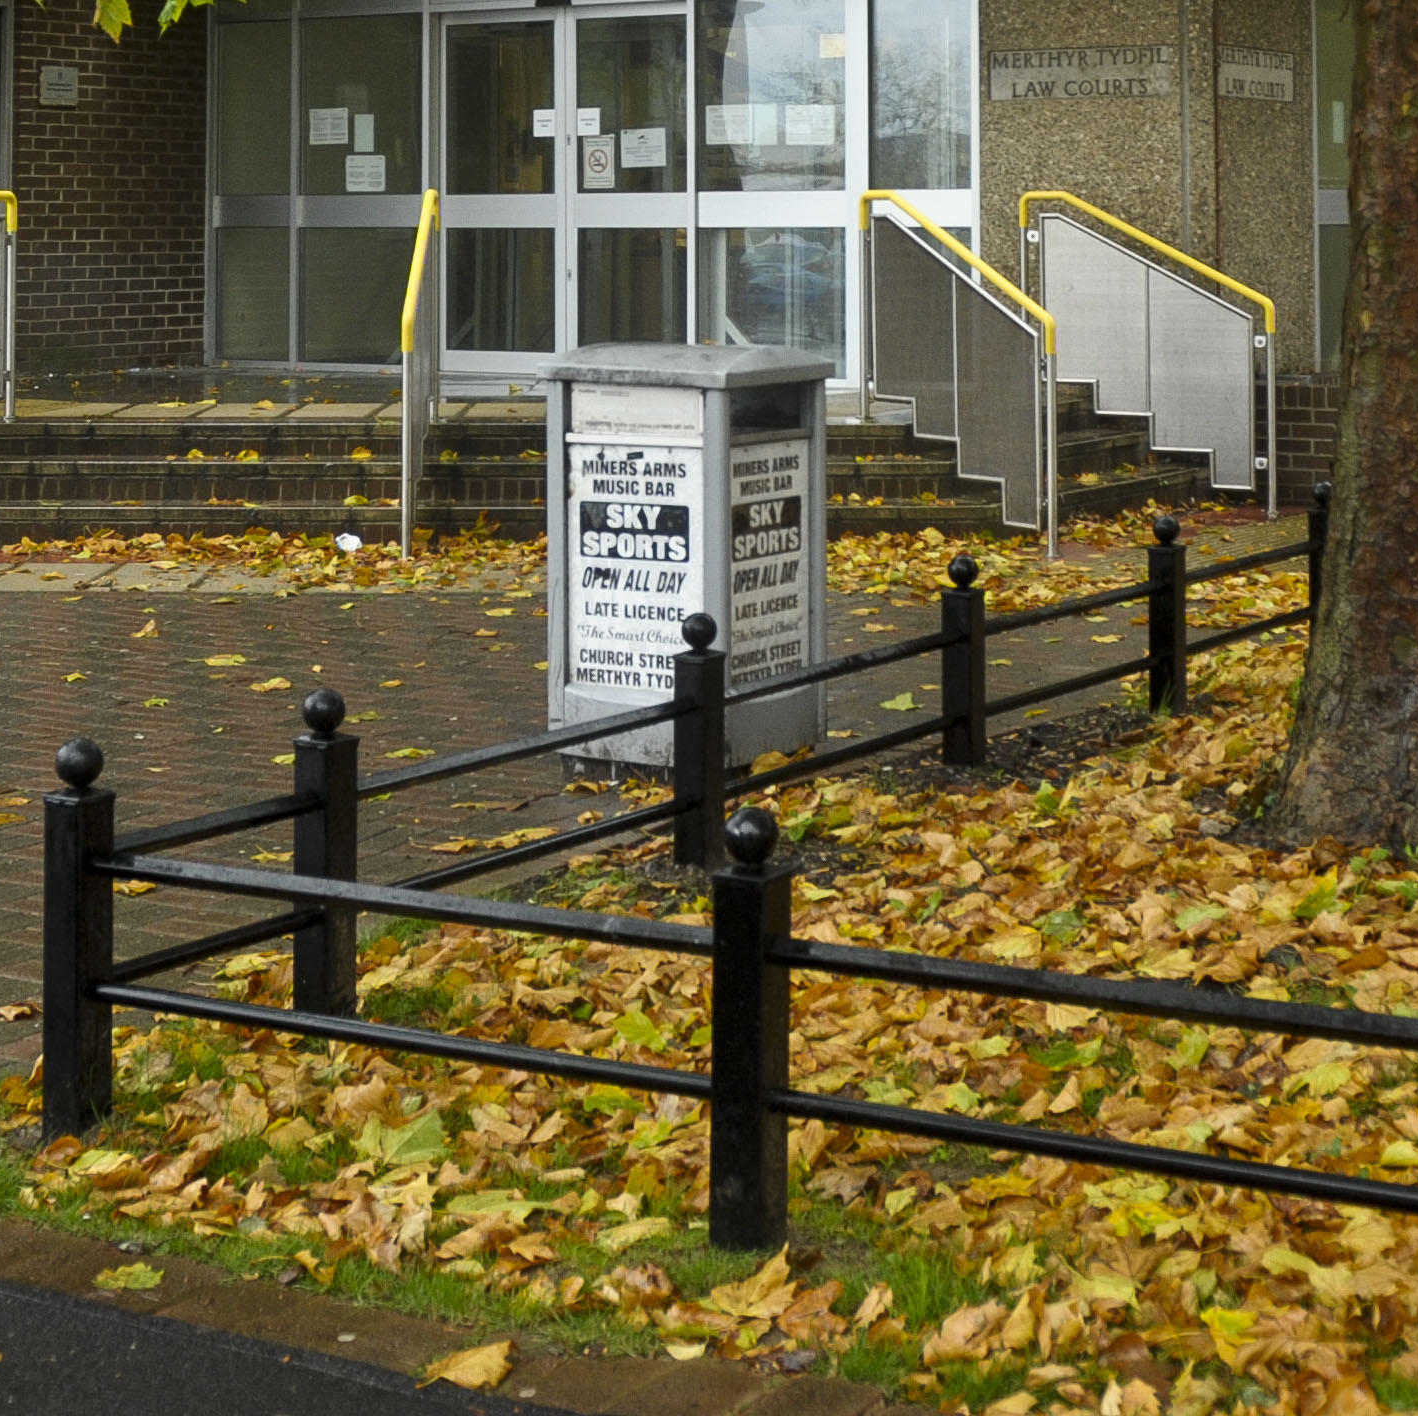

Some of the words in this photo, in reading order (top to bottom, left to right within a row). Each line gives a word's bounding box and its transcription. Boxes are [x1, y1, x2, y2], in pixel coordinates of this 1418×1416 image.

[992, 51, 1090, 69] MERTHYR
[1096, 47, 1169, 66] TYDFIL
[1218, 46, 1261, 68] ERTHYR
[1012, 82, 1056, 98] LAW
[1064, 78, 1149, 97] COURTS
[1225, 77, 1246, 94] LAW
[1249, 80, 1285, 98] COURTS
[582, 460, 638, 477] MINERS
[643, 463, 687, 478] ARMS
[733, 459, 769, 478] MINERS
[772, 454, 800, 473] ARMS
[593, 479, 639, 495] MUSIC
[645, 482, 675, 497] BAR
[740, 478, 771, 496] MUSIC
[773, 475, 792, 492] BAR
[606, 503, 661, 530] SKY
[749, 500, 784, 528] SKY
[582, 530, 687, 561] SPORTS
[734, 526, 799, 559] SPORTS
[582, 566, 621, 590] OPEN
[623, 569, 650, 592] ALL
[656, 571, 687, 594] DAY
[733, 566, 760, 594] OPEN
[759, 564, 777, 589] ALL
[780, 560, 800, 585] DAY
[585, 601, 618, 617] LATE
[624, 604, 685, 622] LICENCE
[735, 603, 758, 621] LATE
[761, 594, 798, 616] LICENCE
[606, 626, 644, 642] Smart
[580, 648, 633, 666] CHURCH
[639, 653, 675, 670] STRE
[732, 649, 768, 671] CHURCH
[769, 640, 801, 662] STREET
[576, 667, 641, 687] MERTHYR
[646, 673, 674, 689] TYD
